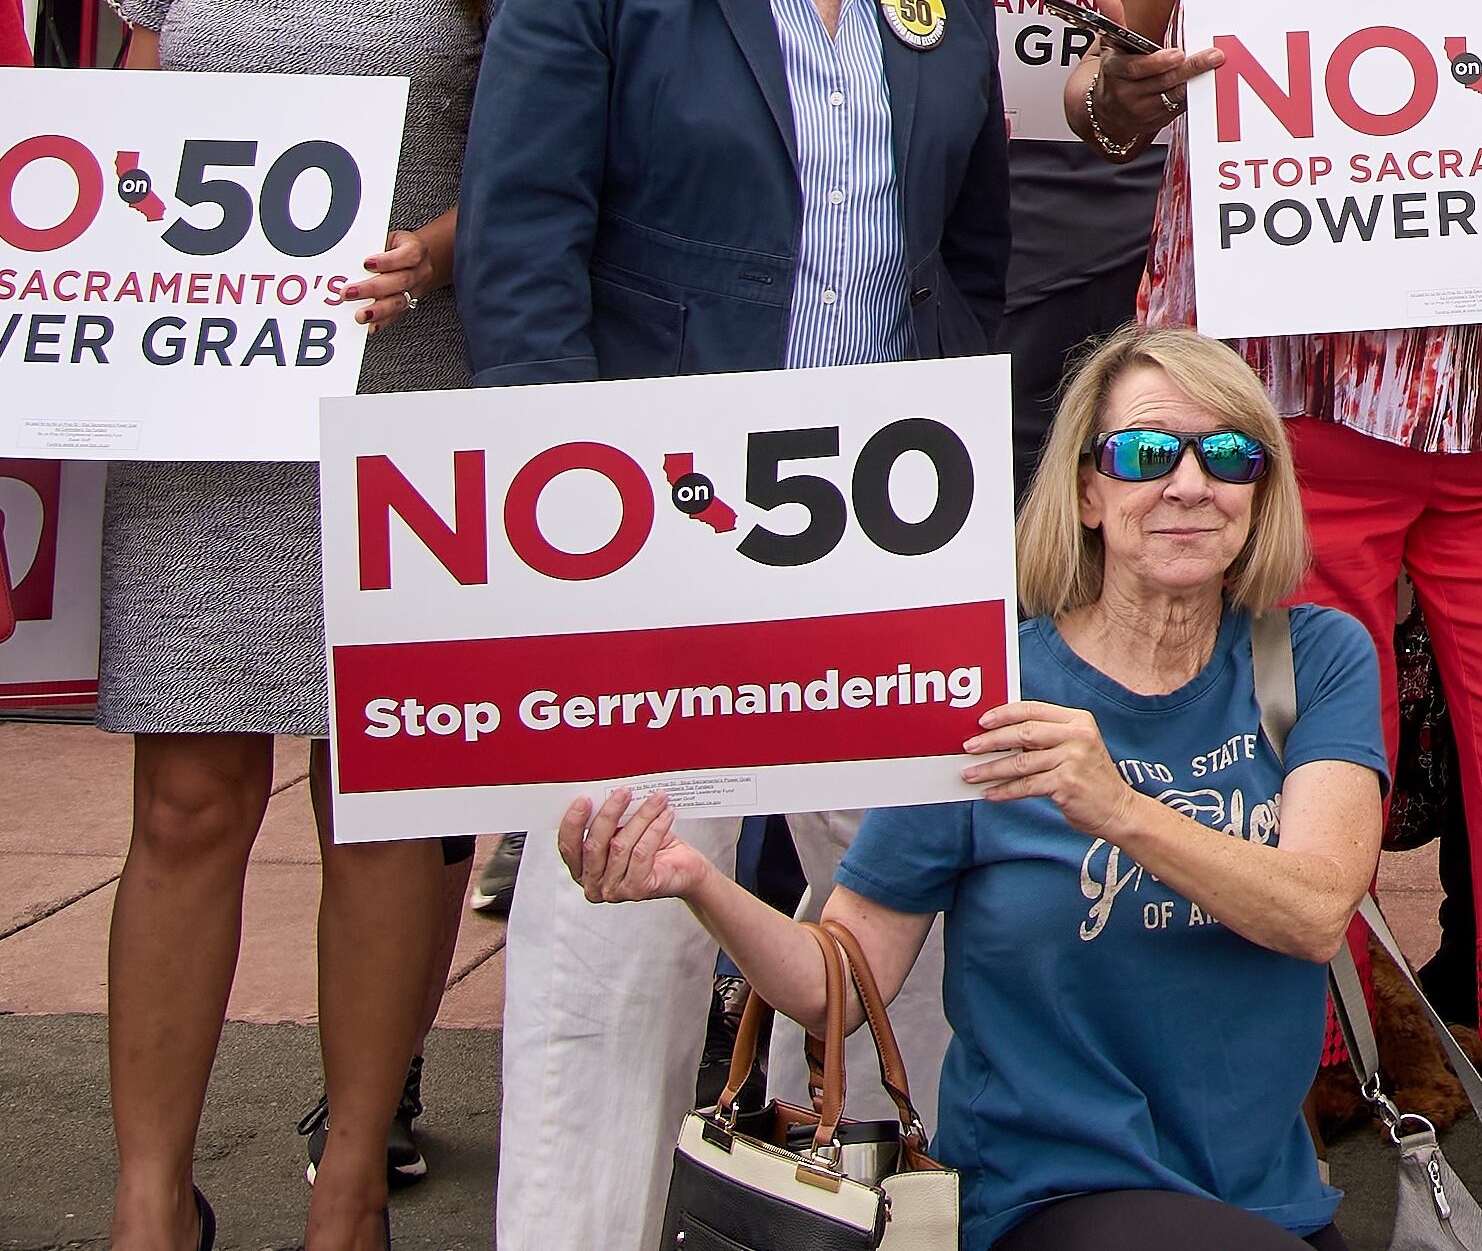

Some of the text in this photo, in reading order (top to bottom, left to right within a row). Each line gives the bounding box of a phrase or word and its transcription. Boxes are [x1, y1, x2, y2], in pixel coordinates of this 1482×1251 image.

[1015, 25, 1096, 66] GR
[1212, 25, 1439, 143] NO
[1454, 60, 1481, 77] on
[121, 177, 149, 195] on
[160, 139, 362, 258] 50
[1218, 156, 1333, 191] STOP
[1220, 190, 1478, 250] POWER
[142, 316, 337, 368] GRAB
[356, 417, 975, 591] NO on 50
[363, 663, 983, 742] Stop Gerrymandering
[1118, 734, 1258, 786] ITED STATE
[1143, 901, 1175, 930] OF
